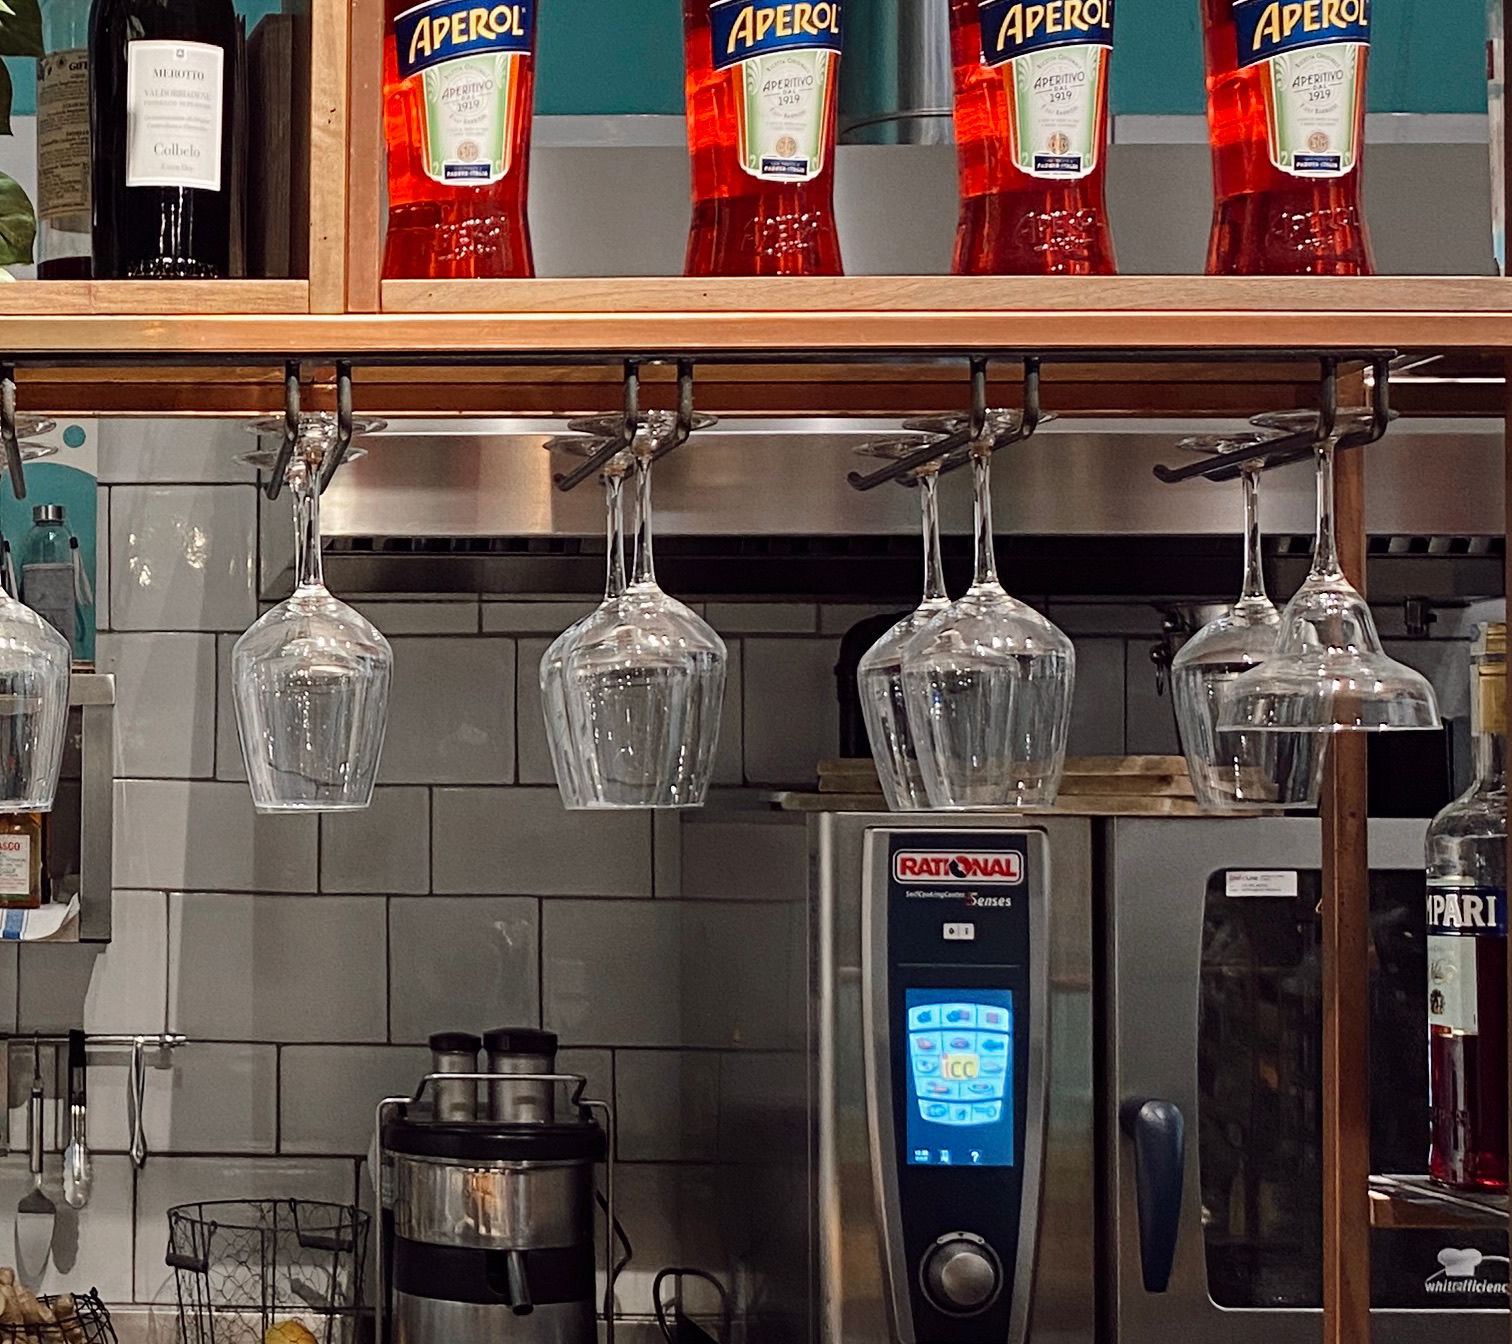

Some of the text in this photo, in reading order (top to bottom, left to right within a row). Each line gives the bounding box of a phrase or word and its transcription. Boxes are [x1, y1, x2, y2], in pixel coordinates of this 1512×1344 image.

[408, 4, 525, 65] APEROL
[726, 1, 840, 55] APEROL
[152, 68, 206, 82] MEROTTO
[762, 75, 814, 93] APERITIVO
[1034, 71, 1086, 90] APERITIVO
[1292, 68, 1345, 88] APERITIVO
[441, 79, 494, 101] APERITIVO
[1049, 91, 1073, 103] 1919
[1308, 89, 1332, 102] 1919
[457, 100, 481, 113] 1919
[778, 95, 801, 107] 1919
[153, 142, 201, 159] Colbelo
[899, 855, 1018, 879] RATIONAL
